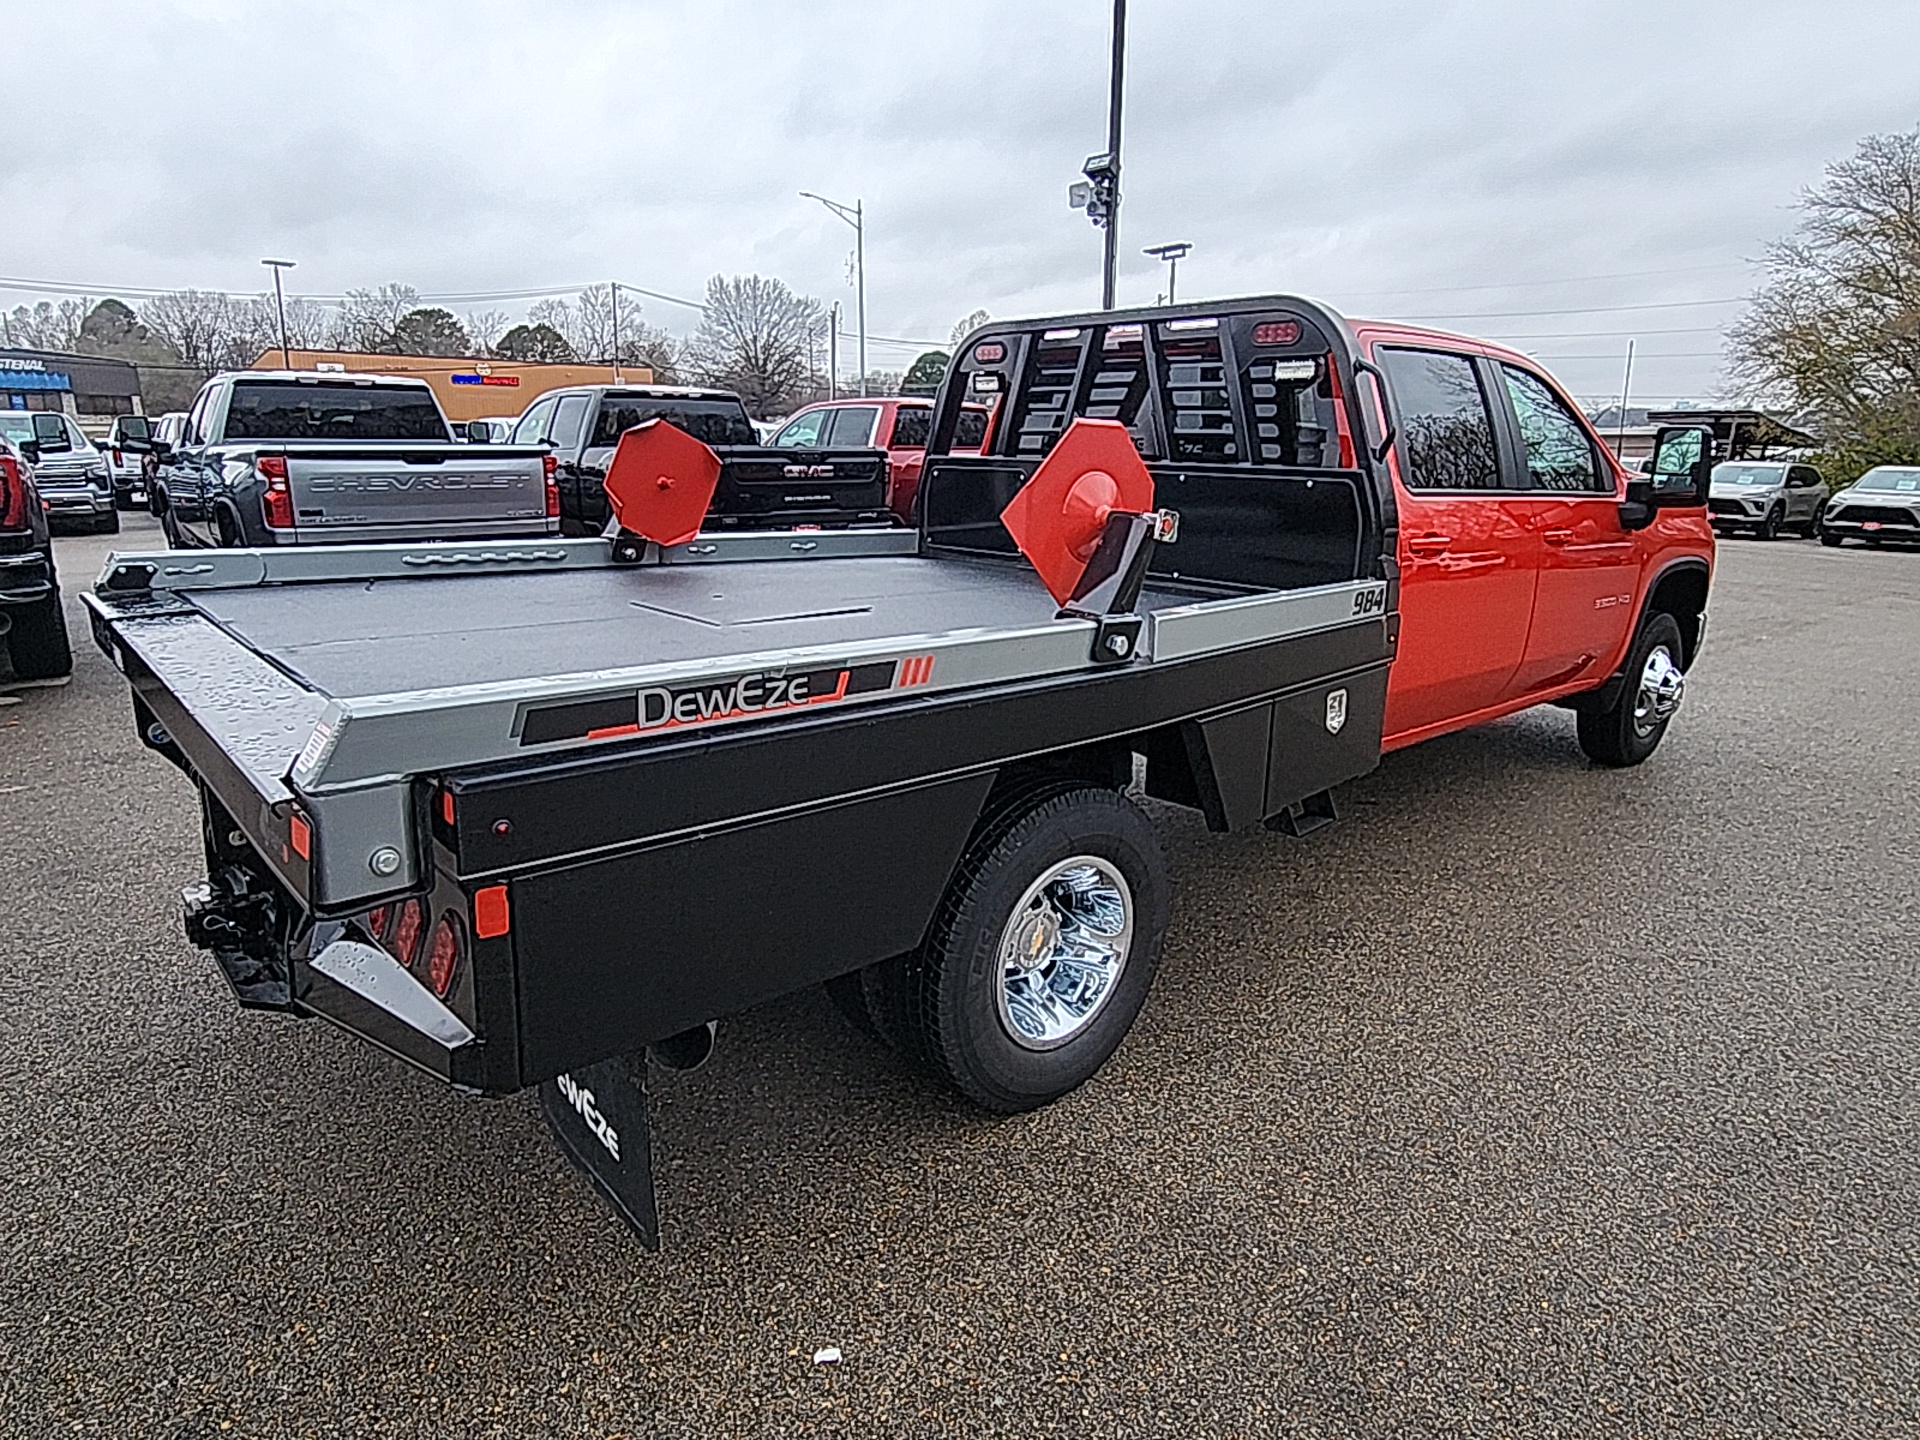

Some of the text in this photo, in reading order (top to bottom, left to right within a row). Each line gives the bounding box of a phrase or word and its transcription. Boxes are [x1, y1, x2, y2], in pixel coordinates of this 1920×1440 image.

[783, 465, 835, 477] GMC
[310, 475, 530, 492] CHEVROLET
[1352, 587, 1385, 616] 984
